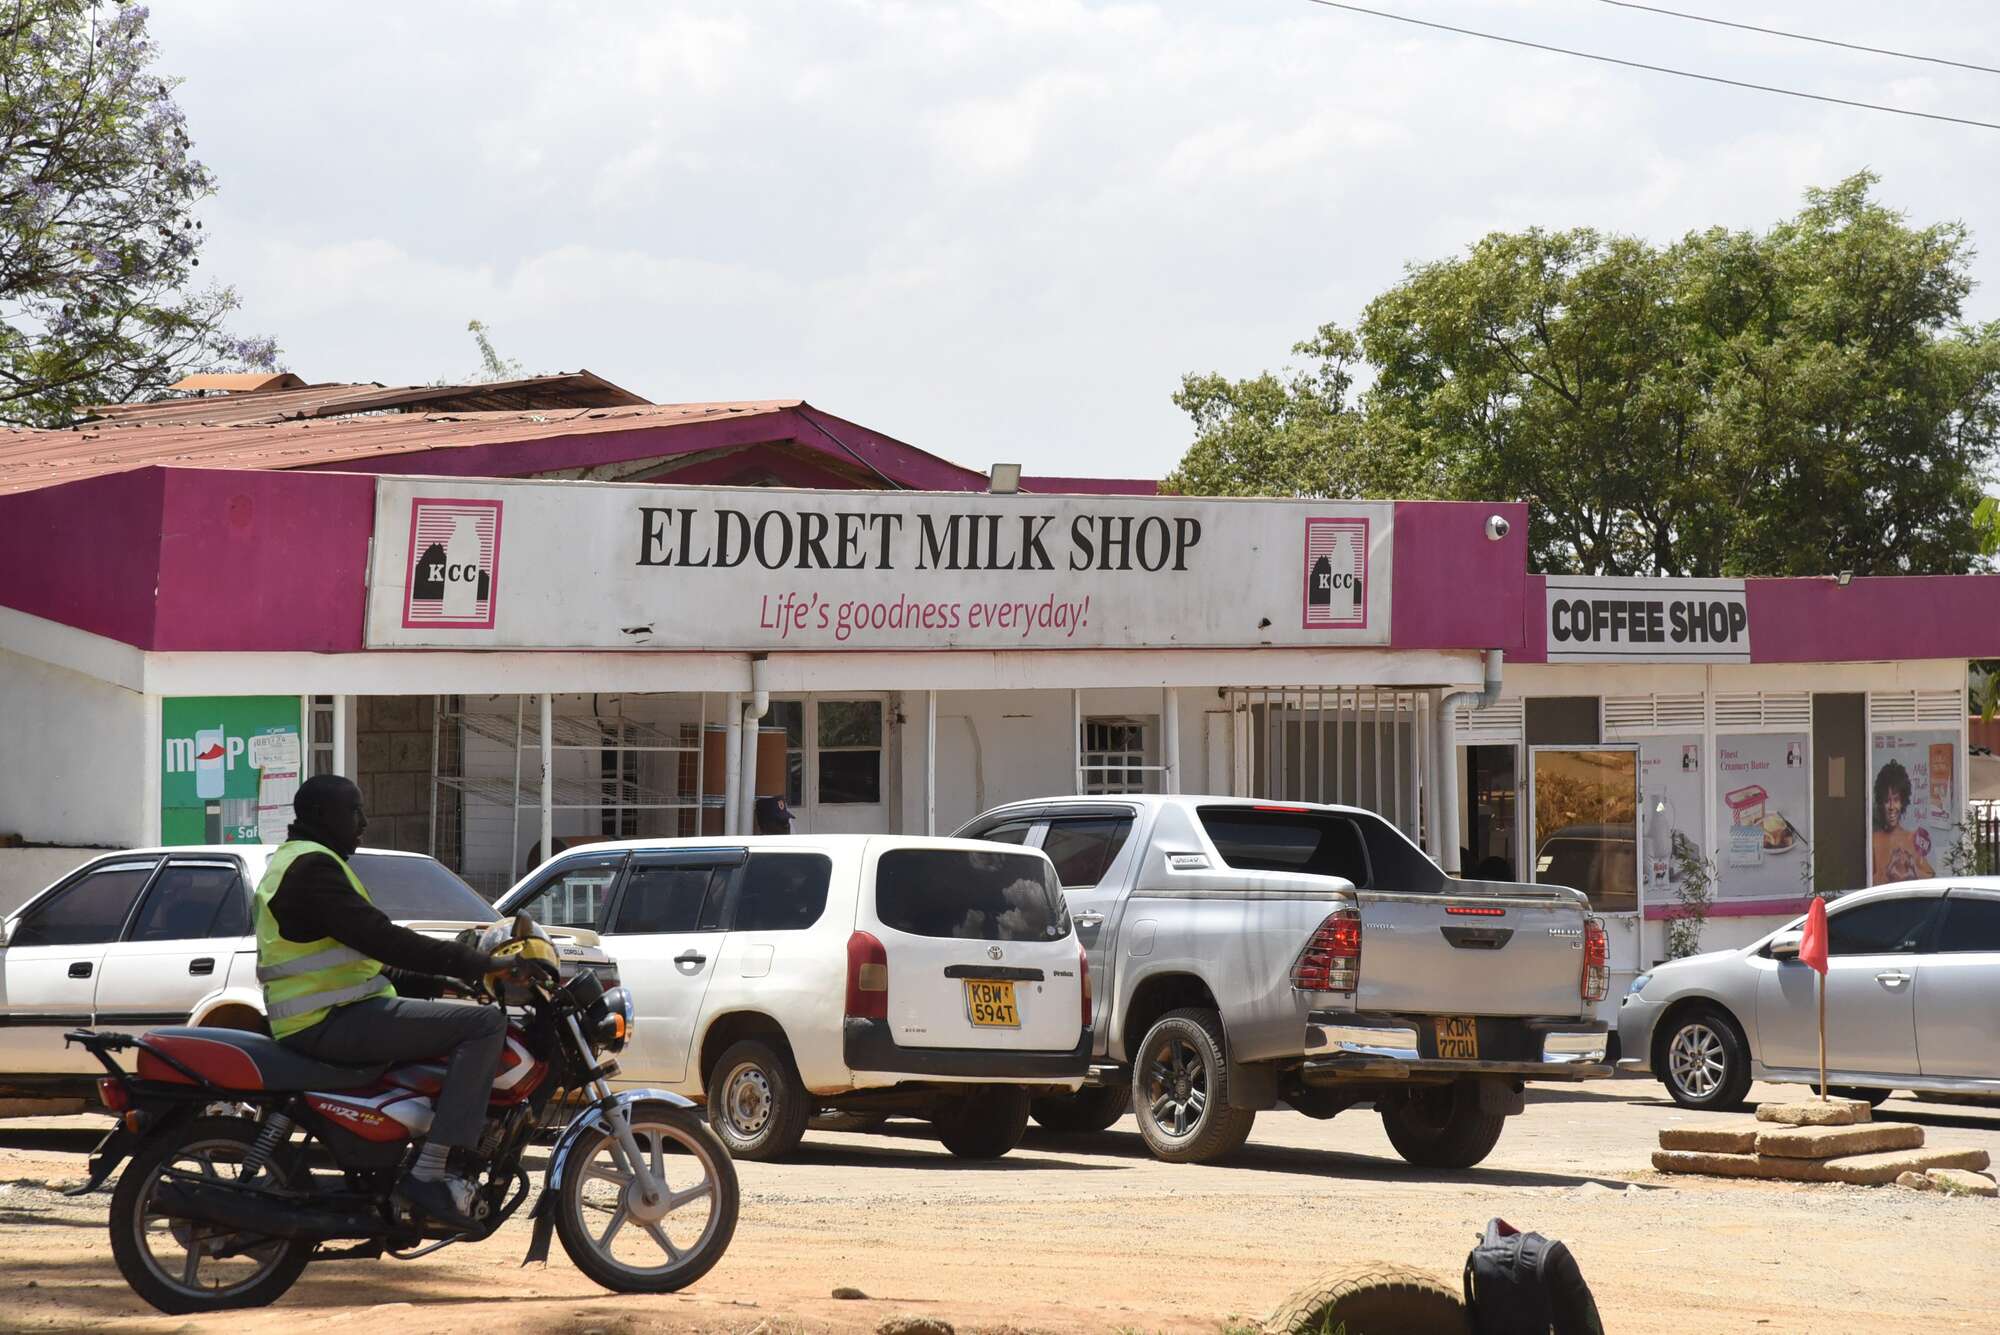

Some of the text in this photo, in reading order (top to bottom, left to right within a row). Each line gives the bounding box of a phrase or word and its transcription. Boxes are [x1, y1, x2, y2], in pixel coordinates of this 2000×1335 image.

[636, 507, 1201, 571] ELDORET MILK SHOP
[427, 563, 477, 582] KCC
[1318, 573, 1353, 589] KCC
[760, 592, 1090, 641] Life's goodness everyday!
[1552, 599, 1746, 643] COFFEE SHOP
[972, 984, 1002, 1003] KBW
[976, 1003, 1013, 1022] 594T
[1447, 1018, 1473, 1037] KDK
